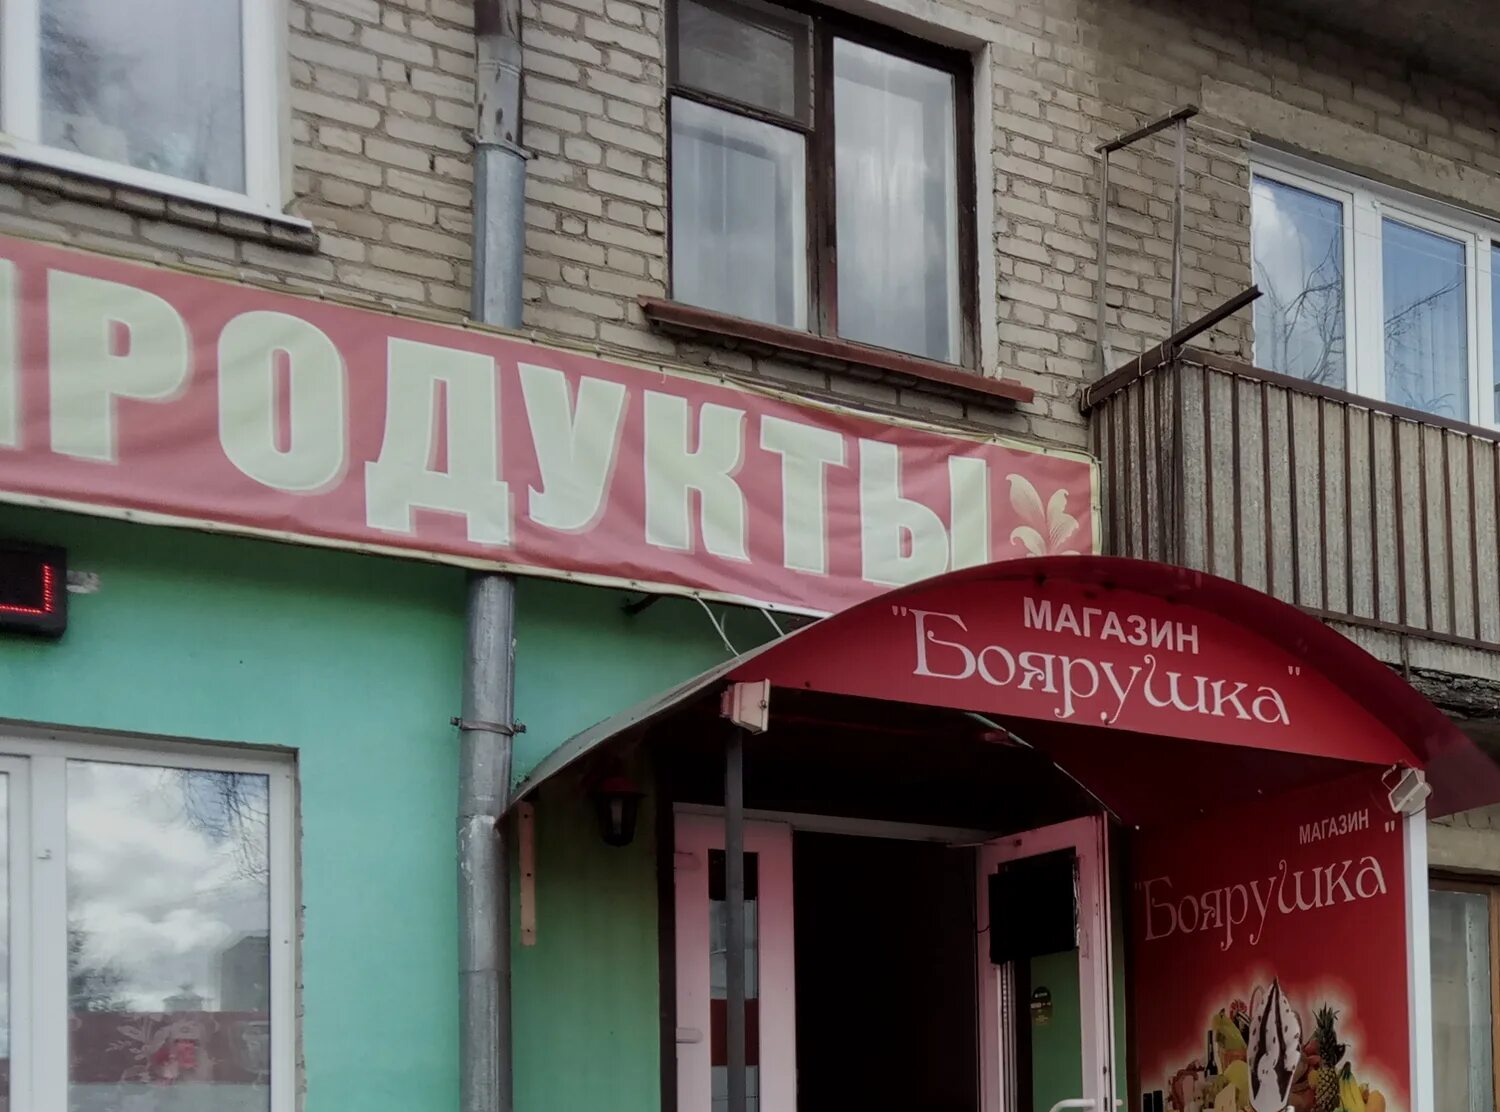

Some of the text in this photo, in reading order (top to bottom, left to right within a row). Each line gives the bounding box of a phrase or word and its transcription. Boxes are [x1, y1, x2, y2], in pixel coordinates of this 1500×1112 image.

[0, 258, 990, 587] РОДУКТЫ
[892, 605, 1301, 726] "Боярушка"
[1023, 597, 1200, 655] МАГАЗИН
[1299, 808, 1369, 845] МАГАЗИН
